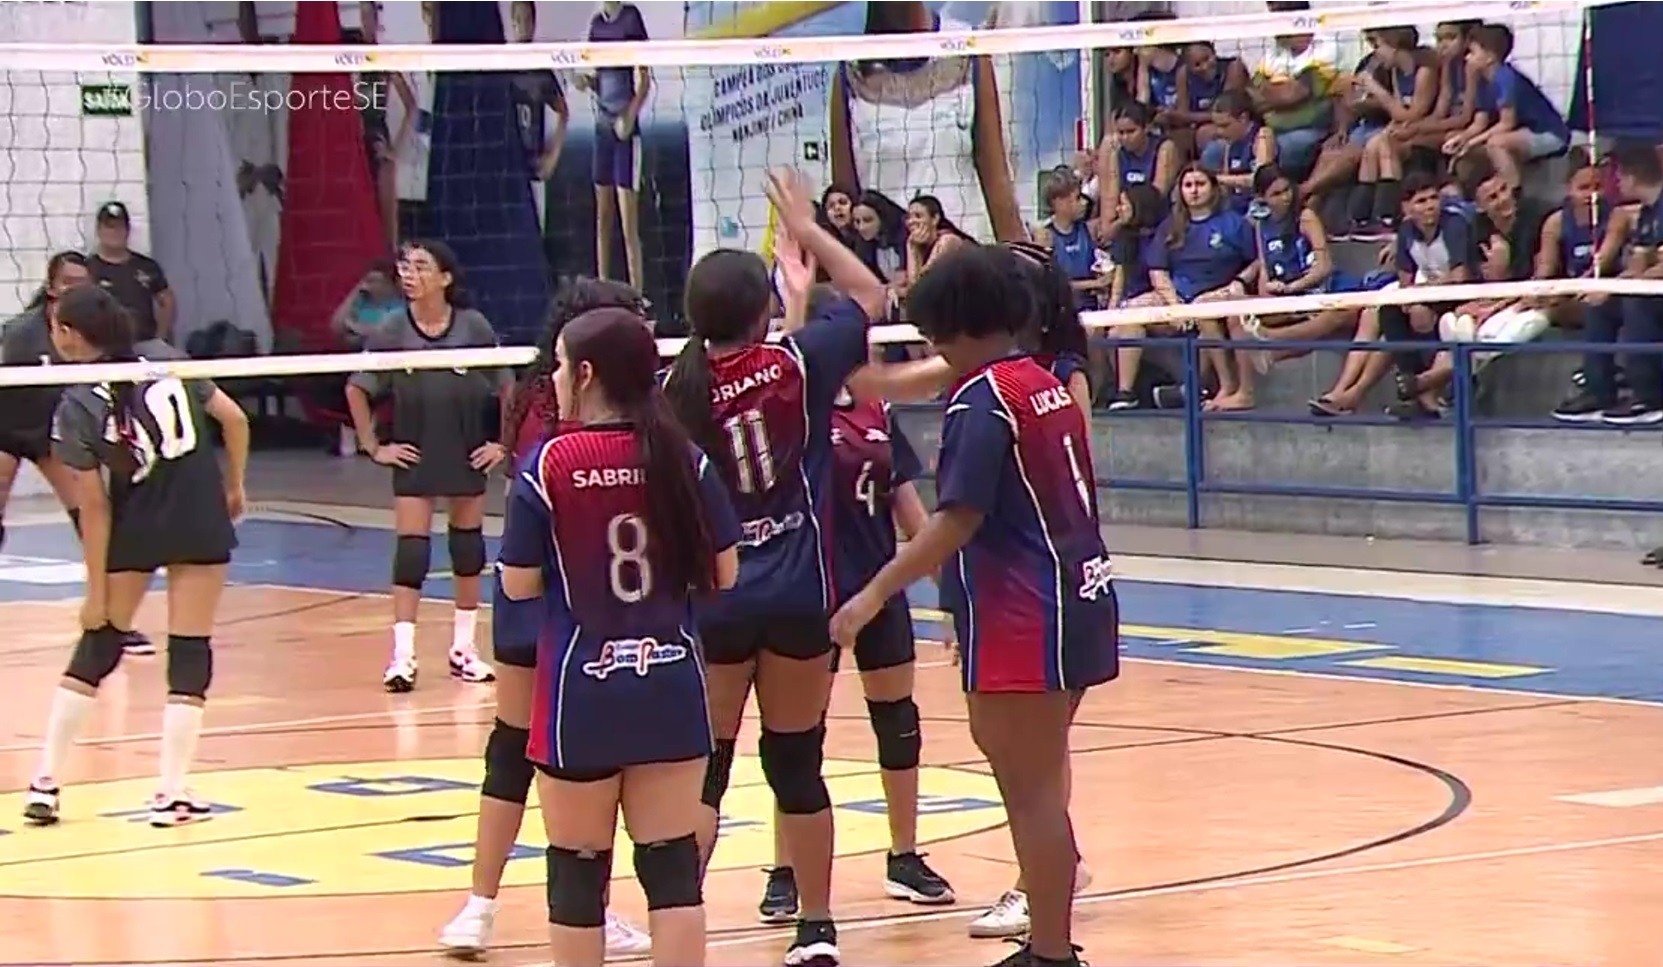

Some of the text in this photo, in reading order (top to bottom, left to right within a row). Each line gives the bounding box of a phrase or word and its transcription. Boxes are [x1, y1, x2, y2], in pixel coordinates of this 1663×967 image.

[1029, 385, 1073, 417] LUCAS
[723, 408, 777, 494] 11
[856, 460, 876, 518] 4
[607, 512, 653, 603] 8
